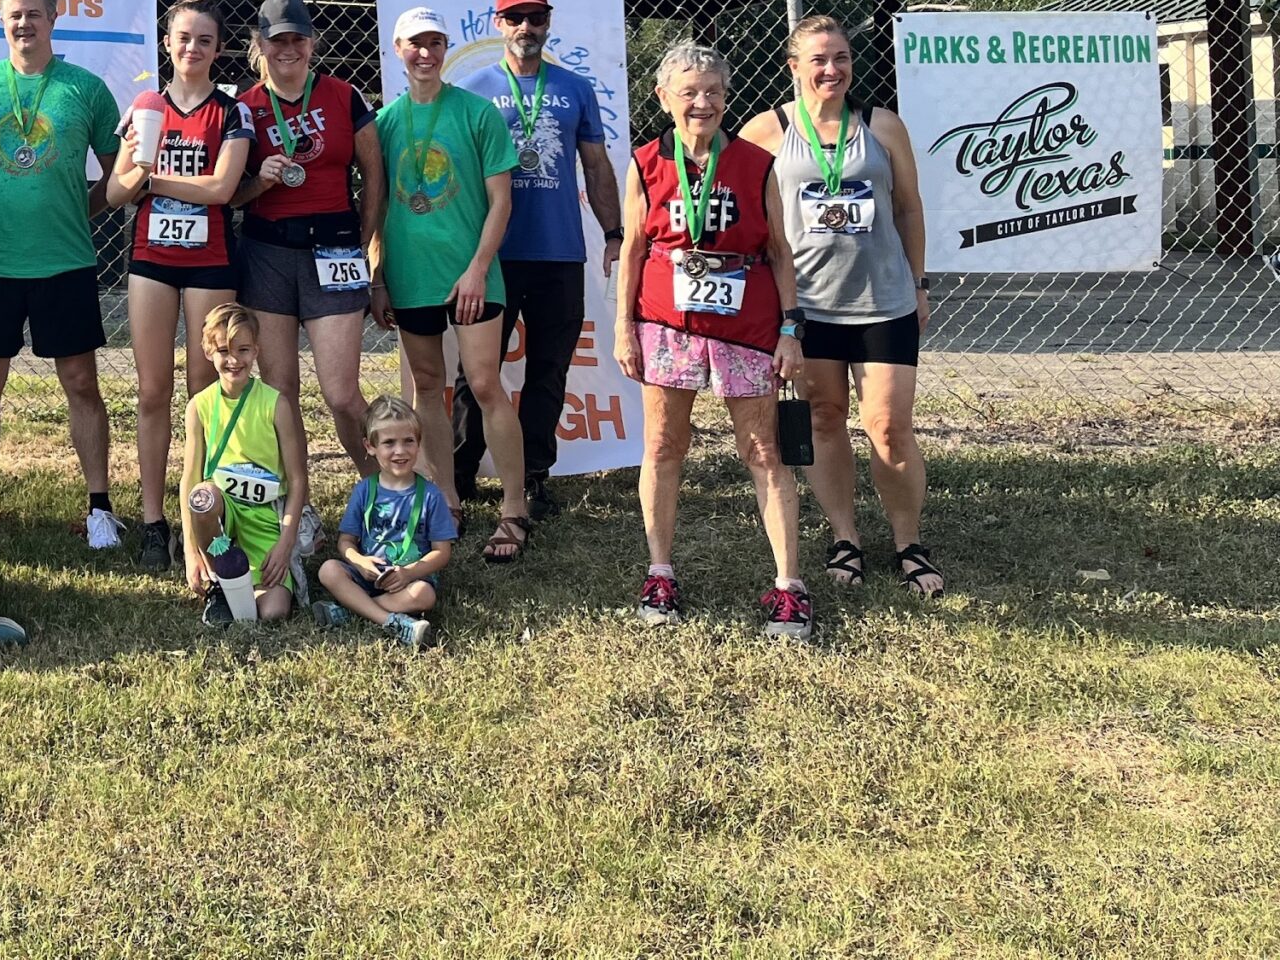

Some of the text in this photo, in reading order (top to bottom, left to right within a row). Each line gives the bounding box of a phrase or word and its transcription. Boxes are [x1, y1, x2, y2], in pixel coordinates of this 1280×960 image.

[987, 35, 1007, 64] &
[160, 135, 206, 152] fueled by
[928, 81, 1097, 195] Taylor
[158, 149, 206, 176] BEEF
[533, 179, 561, 189] SHADY
[717, 180, 733, 201] by
[1015, 150, 1132, 212] Texas
[816, 202, 862, 225] 20
[997, 203, 1104, 236] CITY OF TAYLOR TX
[158, 218, 197, 240] 257
[328, 262, 361, 283] 256
[687, 279, 733, 306] 223
[225, 477, 266, 503] 219
